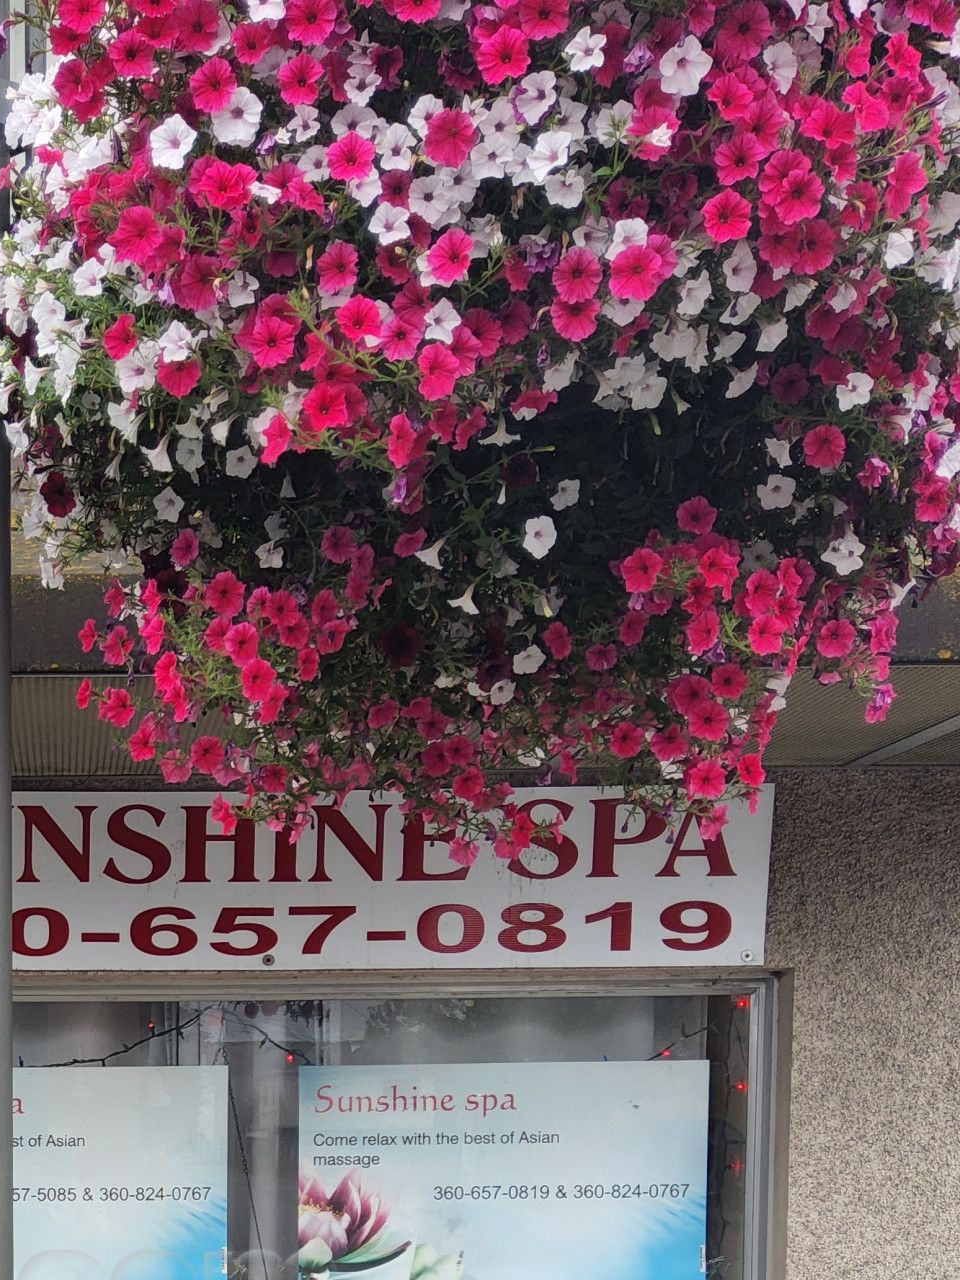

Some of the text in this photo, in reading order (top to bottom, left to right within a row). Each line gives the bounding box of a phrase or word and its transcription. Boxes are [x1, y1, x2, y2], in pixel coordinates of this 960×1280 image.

[507, 798, 737, 879] SPA
[315, 1085, 518, 1117] Sunshine spa
[28, 1135, 42, 1147] of
[46, 1134, 85, 1147] Asian
[313, 1131, 560, 1146] Come relax with the best of Asian
[313, 1154, 380, 1168] massage
[83, 1187, 93, 1202] &
[99, 1186, 212, 1201] 360-824-0767
[433, 1183, 691, 1200] 360-657-0819 & 360-824-0767
